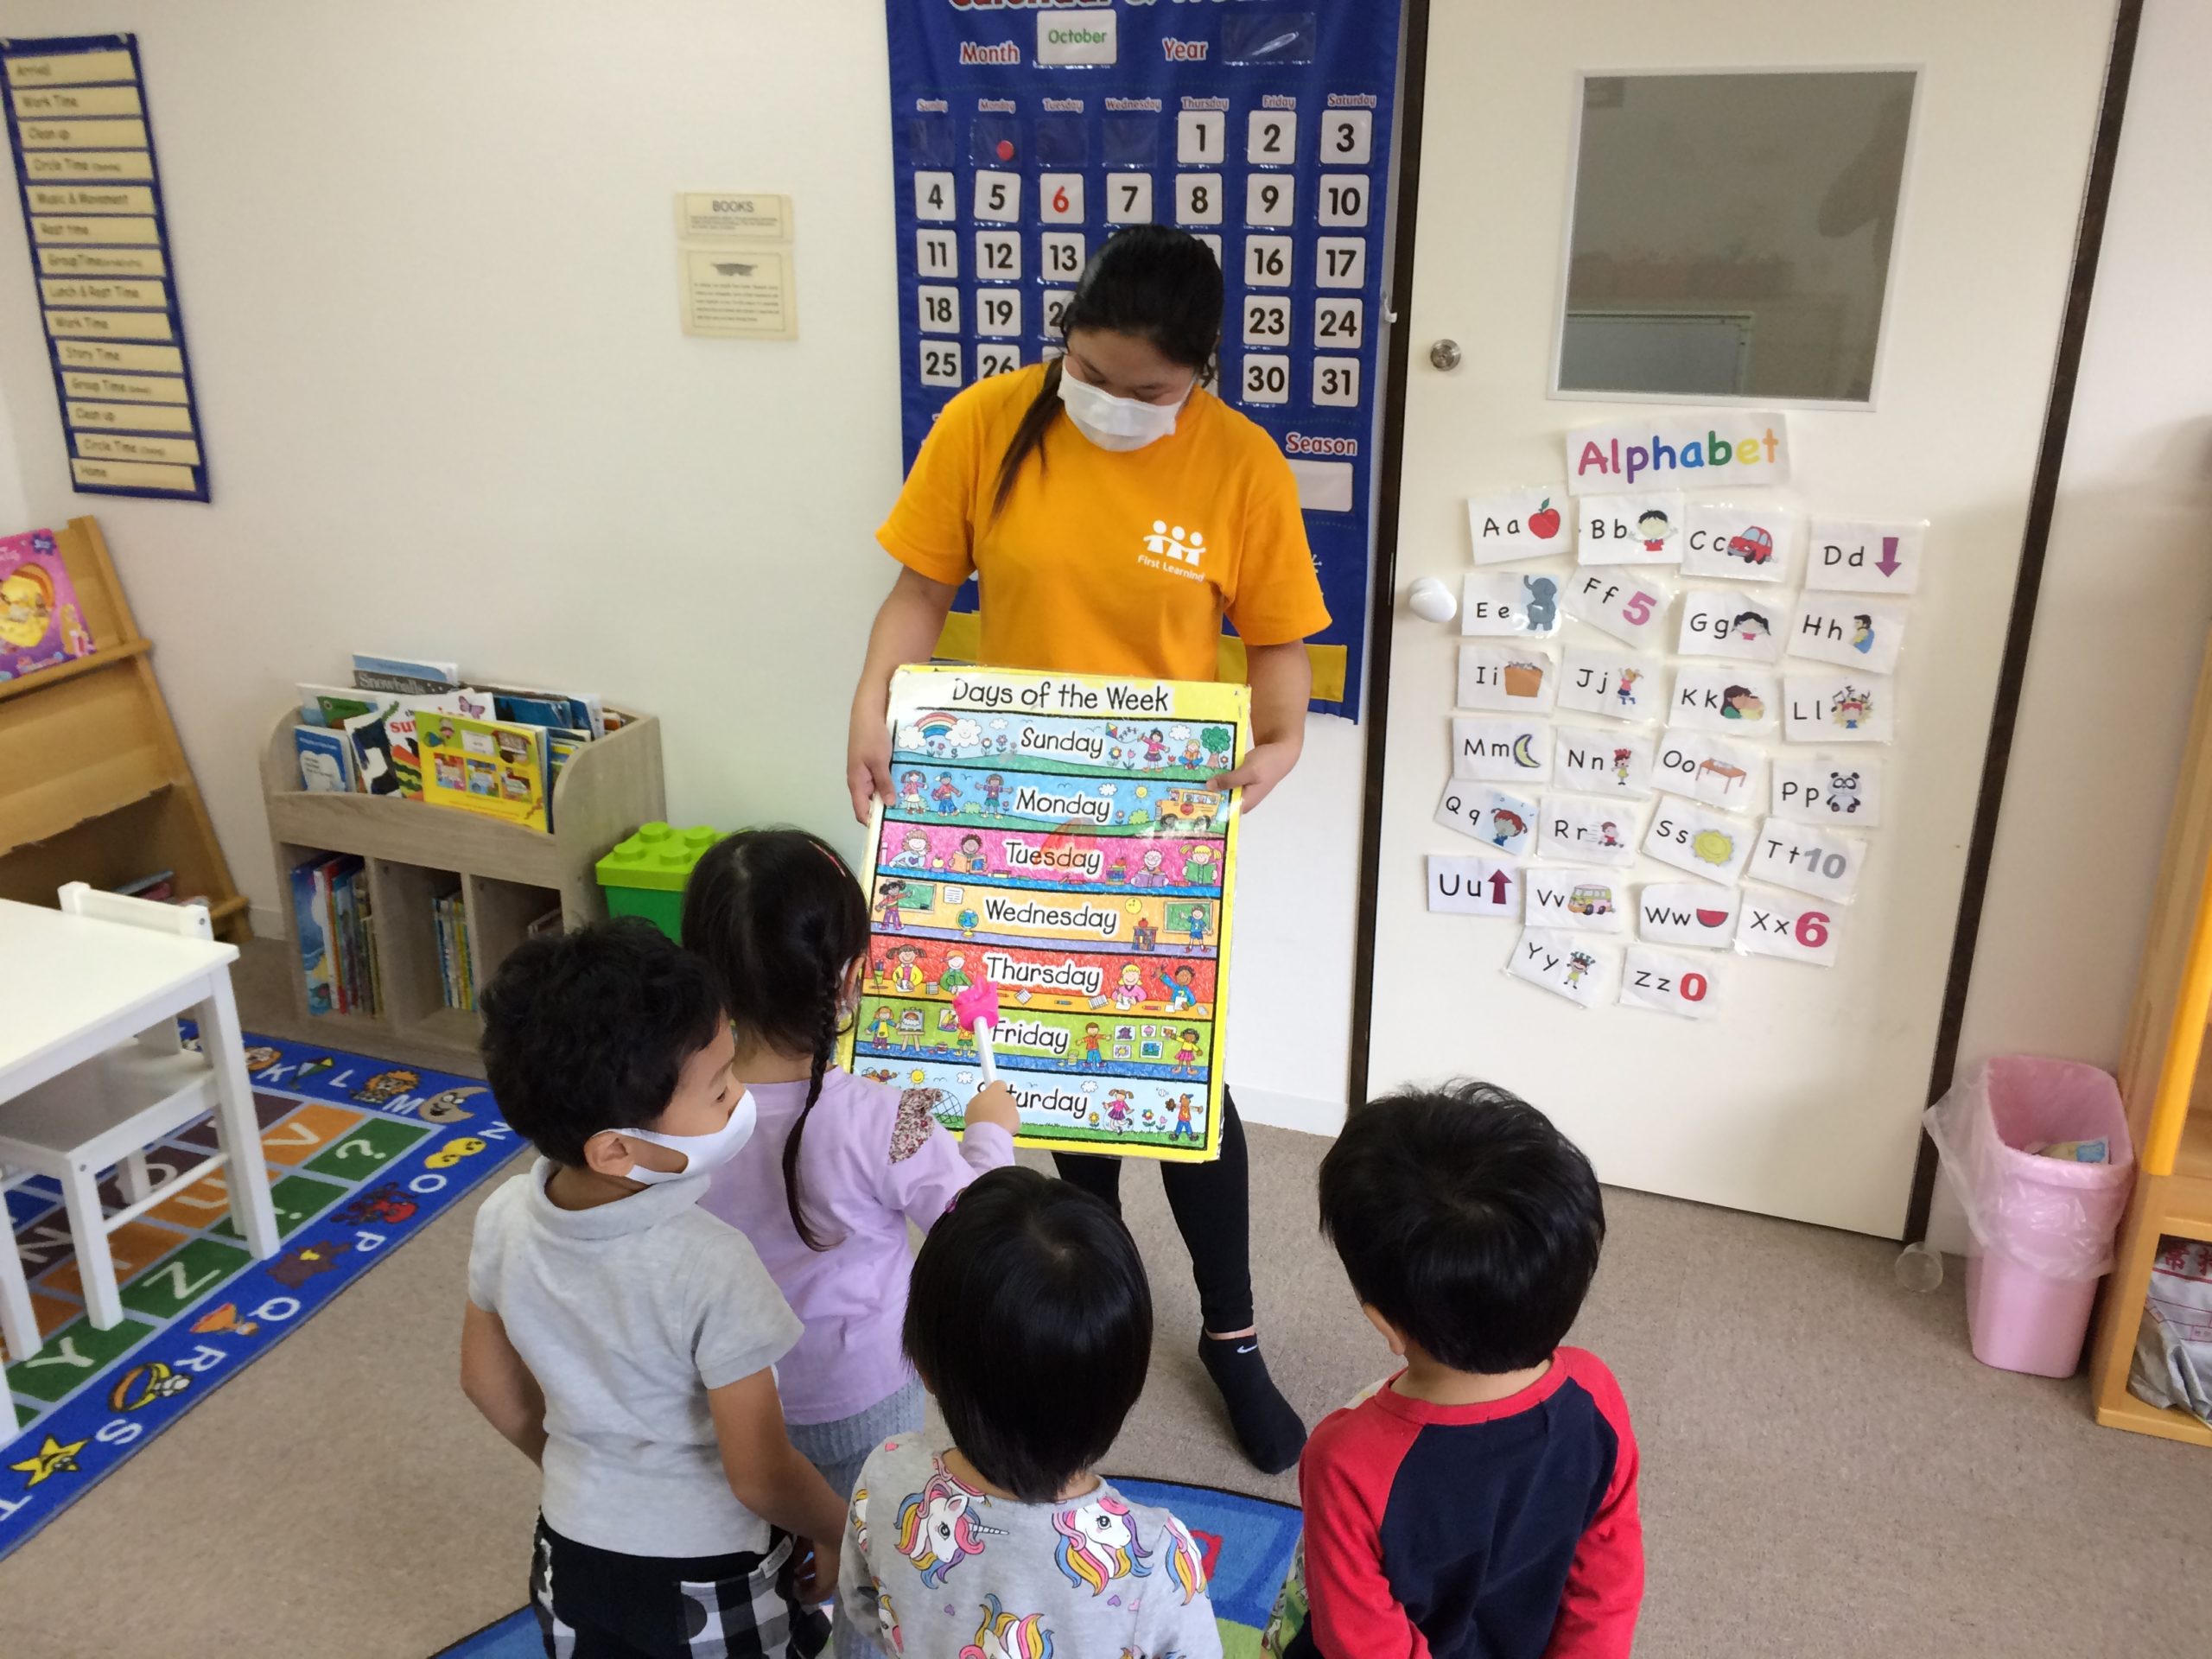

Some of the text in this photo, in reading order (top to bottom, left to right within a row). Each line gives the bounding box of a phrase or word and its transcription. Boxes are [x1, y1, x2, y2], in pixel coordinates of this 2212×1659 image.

[960, 29, 1108, 65] Month October
[1162, 37, 1209, 61] Year
[978, 99, 1016, 114] Monday
[1042, 98, 1084, 114] Tuesday
[1105, 97, 1162, 112] Wednesday
[1180, 97, 1230, 111] Thursday
[1262, 94, 1296, 111] Friday
[1327, 92, 1377, 108] Saturday
[1195, 123, 1355, 153] 1 2 3
[712, 200, 754, 213] BOOKS
[927, 184, 1361, 216] 4 5 6 7 8 9 10
[926, 241, 1357, 277] 11 12 13 16 17
[925, 296, 1357, 338] 18 19 2 23 24
[925, 351, 957, 378] 25
[1247, 365, 1286, 393] 30
[1320, 368, 1351, 397] 31
[1286, 431, 1358, 456] Season
[1578, 429, 1779, 484] Alphabet
[1138, 554, 1160, 569] First
[1622, 591, 1657, 626] 5
[953, 677, 1170, 712] Days of the Week
[1020, 726, 1104, 760] Sunday
[1015, 788, 1111, 822] Monday
[1005, 841, 1101, 874] Tuesday
[1803, 848, 1847, 880] 10
[986, 899, 1118, 935] Wednesday
[1795, 911, 1831, 948] 6
[987, 956, 1102, 994] Thursday
[1680, 973, 1707, 1001] 0
[991, 1020, 1069, 1054] Friday
[256, 1063, 297, 1082] K
[328, 1069, 355, 1087] L
[382, 1094, 425, 1114] M
[409, 1173, 447, 1193] O
[355, 1230, 386, 1251] P
[246, 1297, 301, 1320] Q
[25, 1336, 95, 1368] Y
[174, 1344, 227, 1372] R
[95, 1419, 143, 1445] S
